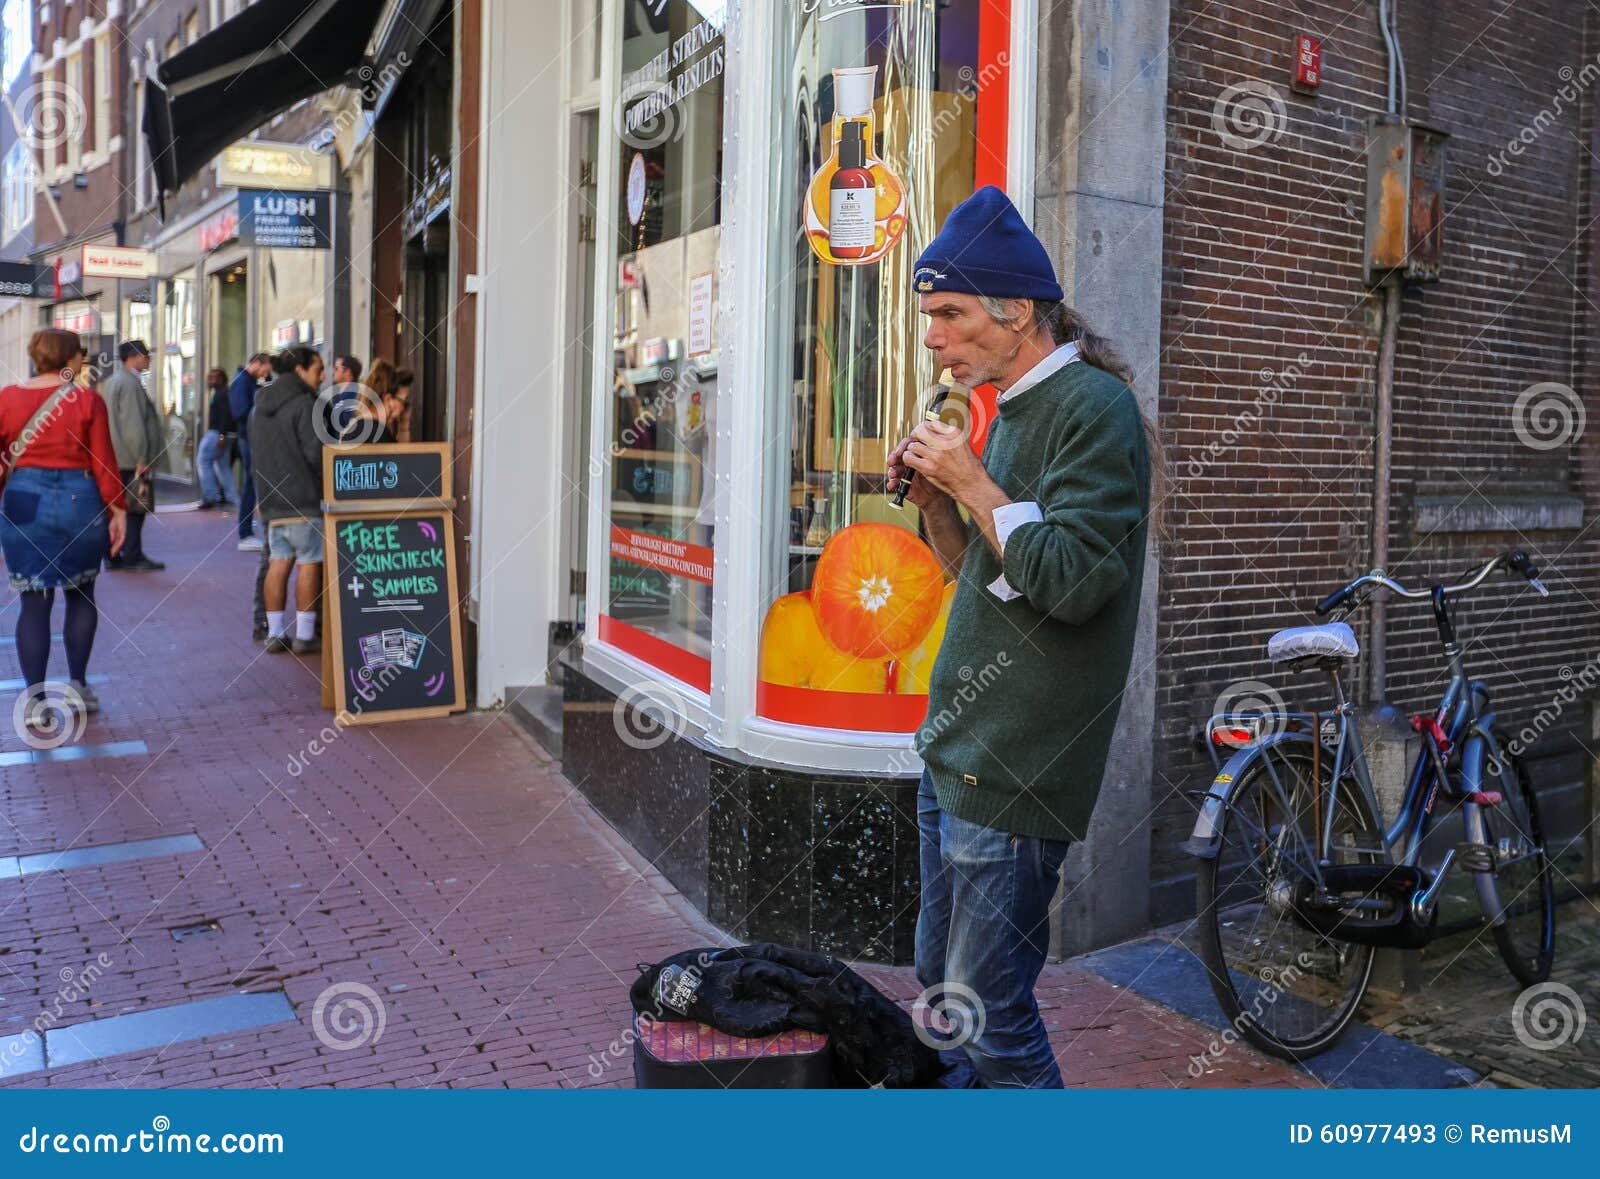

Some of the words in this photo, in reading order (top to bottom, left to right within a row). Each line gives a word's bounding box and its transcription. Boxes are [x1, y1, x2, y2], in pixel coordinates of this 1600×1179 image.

[676, 45, 724, 102] RESULTS
[254, 197, 316, 216] LUSH
[339, 521, 401, 552] FREE
[355, 548, 445, 575] SKINCHECK
[680, 559, 712, 580] CONCENTRATE
[371, 575, 438, 598] SAMPLES
